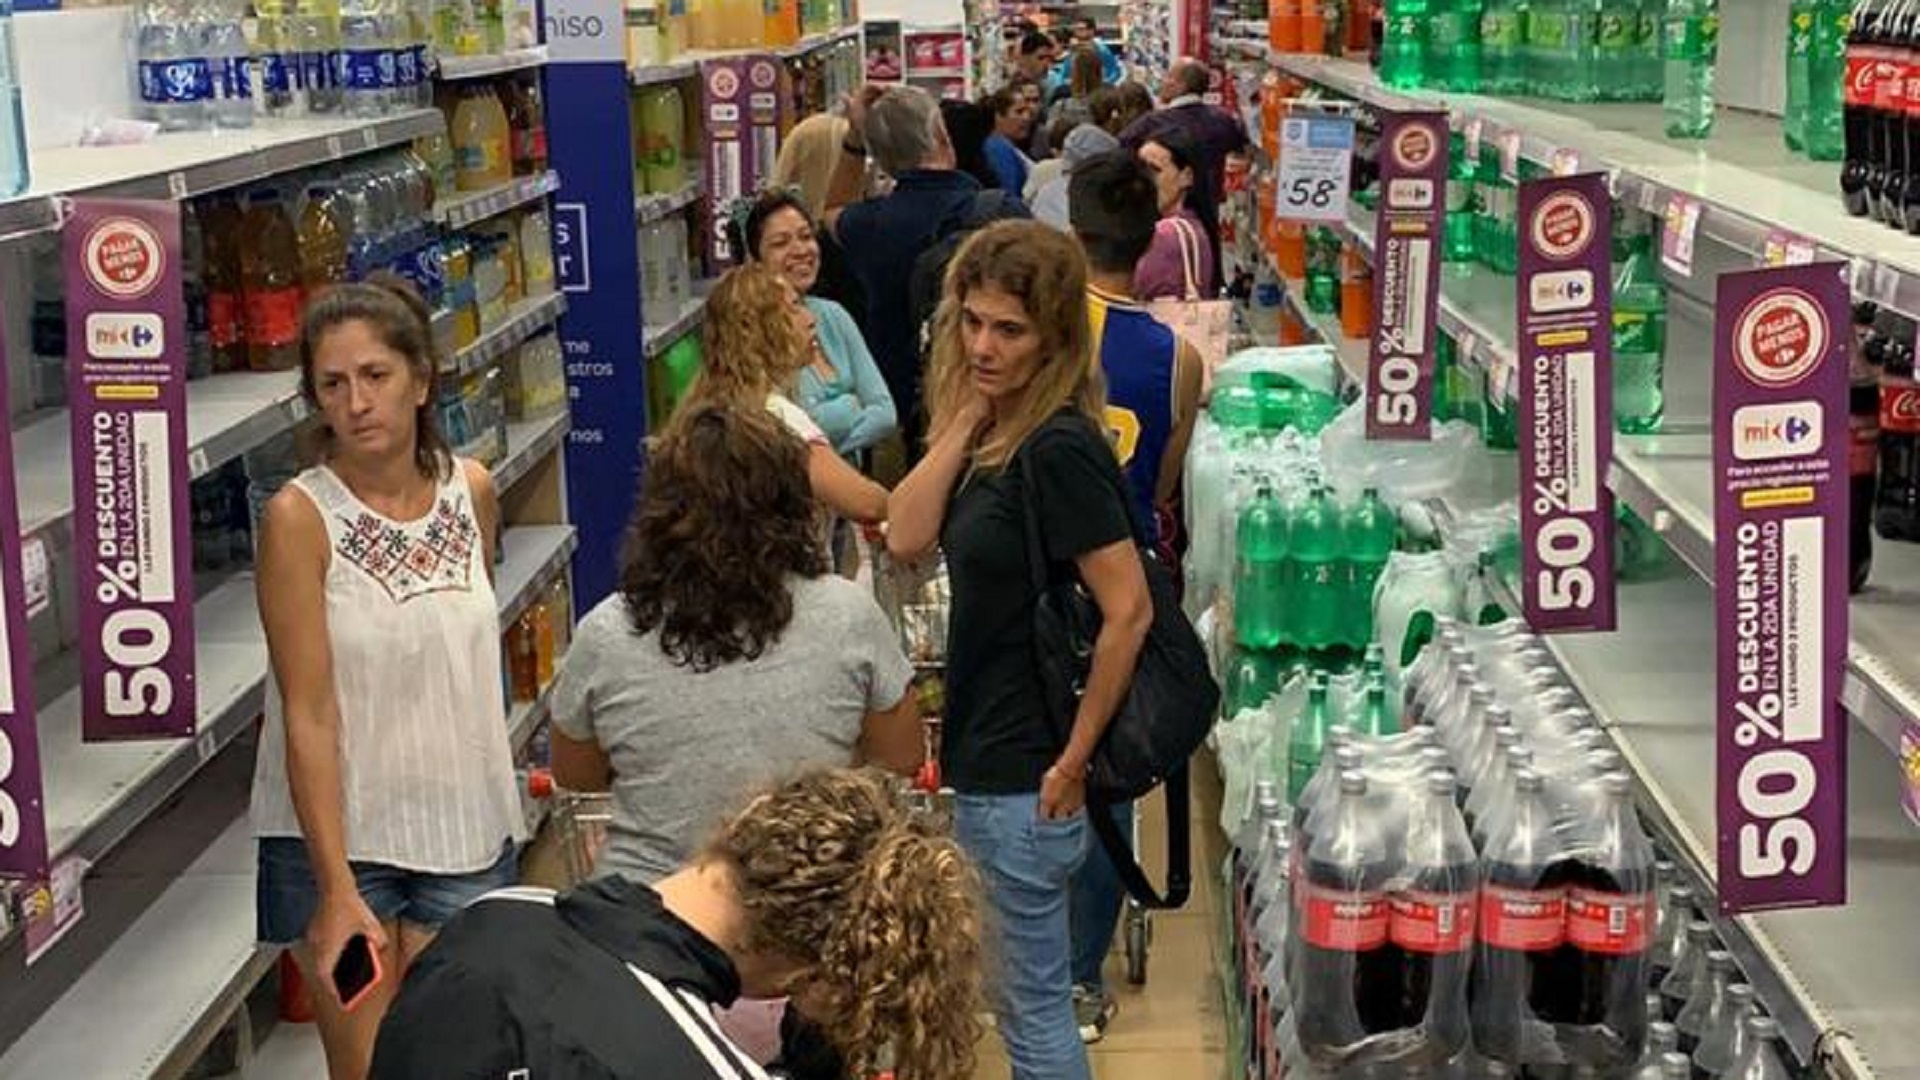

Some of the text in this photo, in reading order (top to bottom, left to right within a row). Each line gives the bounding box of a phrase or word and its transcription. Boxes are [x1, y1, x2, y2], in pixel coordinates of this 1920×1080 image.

[93, 411, 117, 558] DESCUENTO
[1534, 355, 1550, 476] DESCUENTO
[1736, 522, 1760, 693] DESCUENTO
[1761, 520, 1779, 690] EN LA 2DA UNIDAD
[1788, 554, 1799, 630] PRODUCTOS
